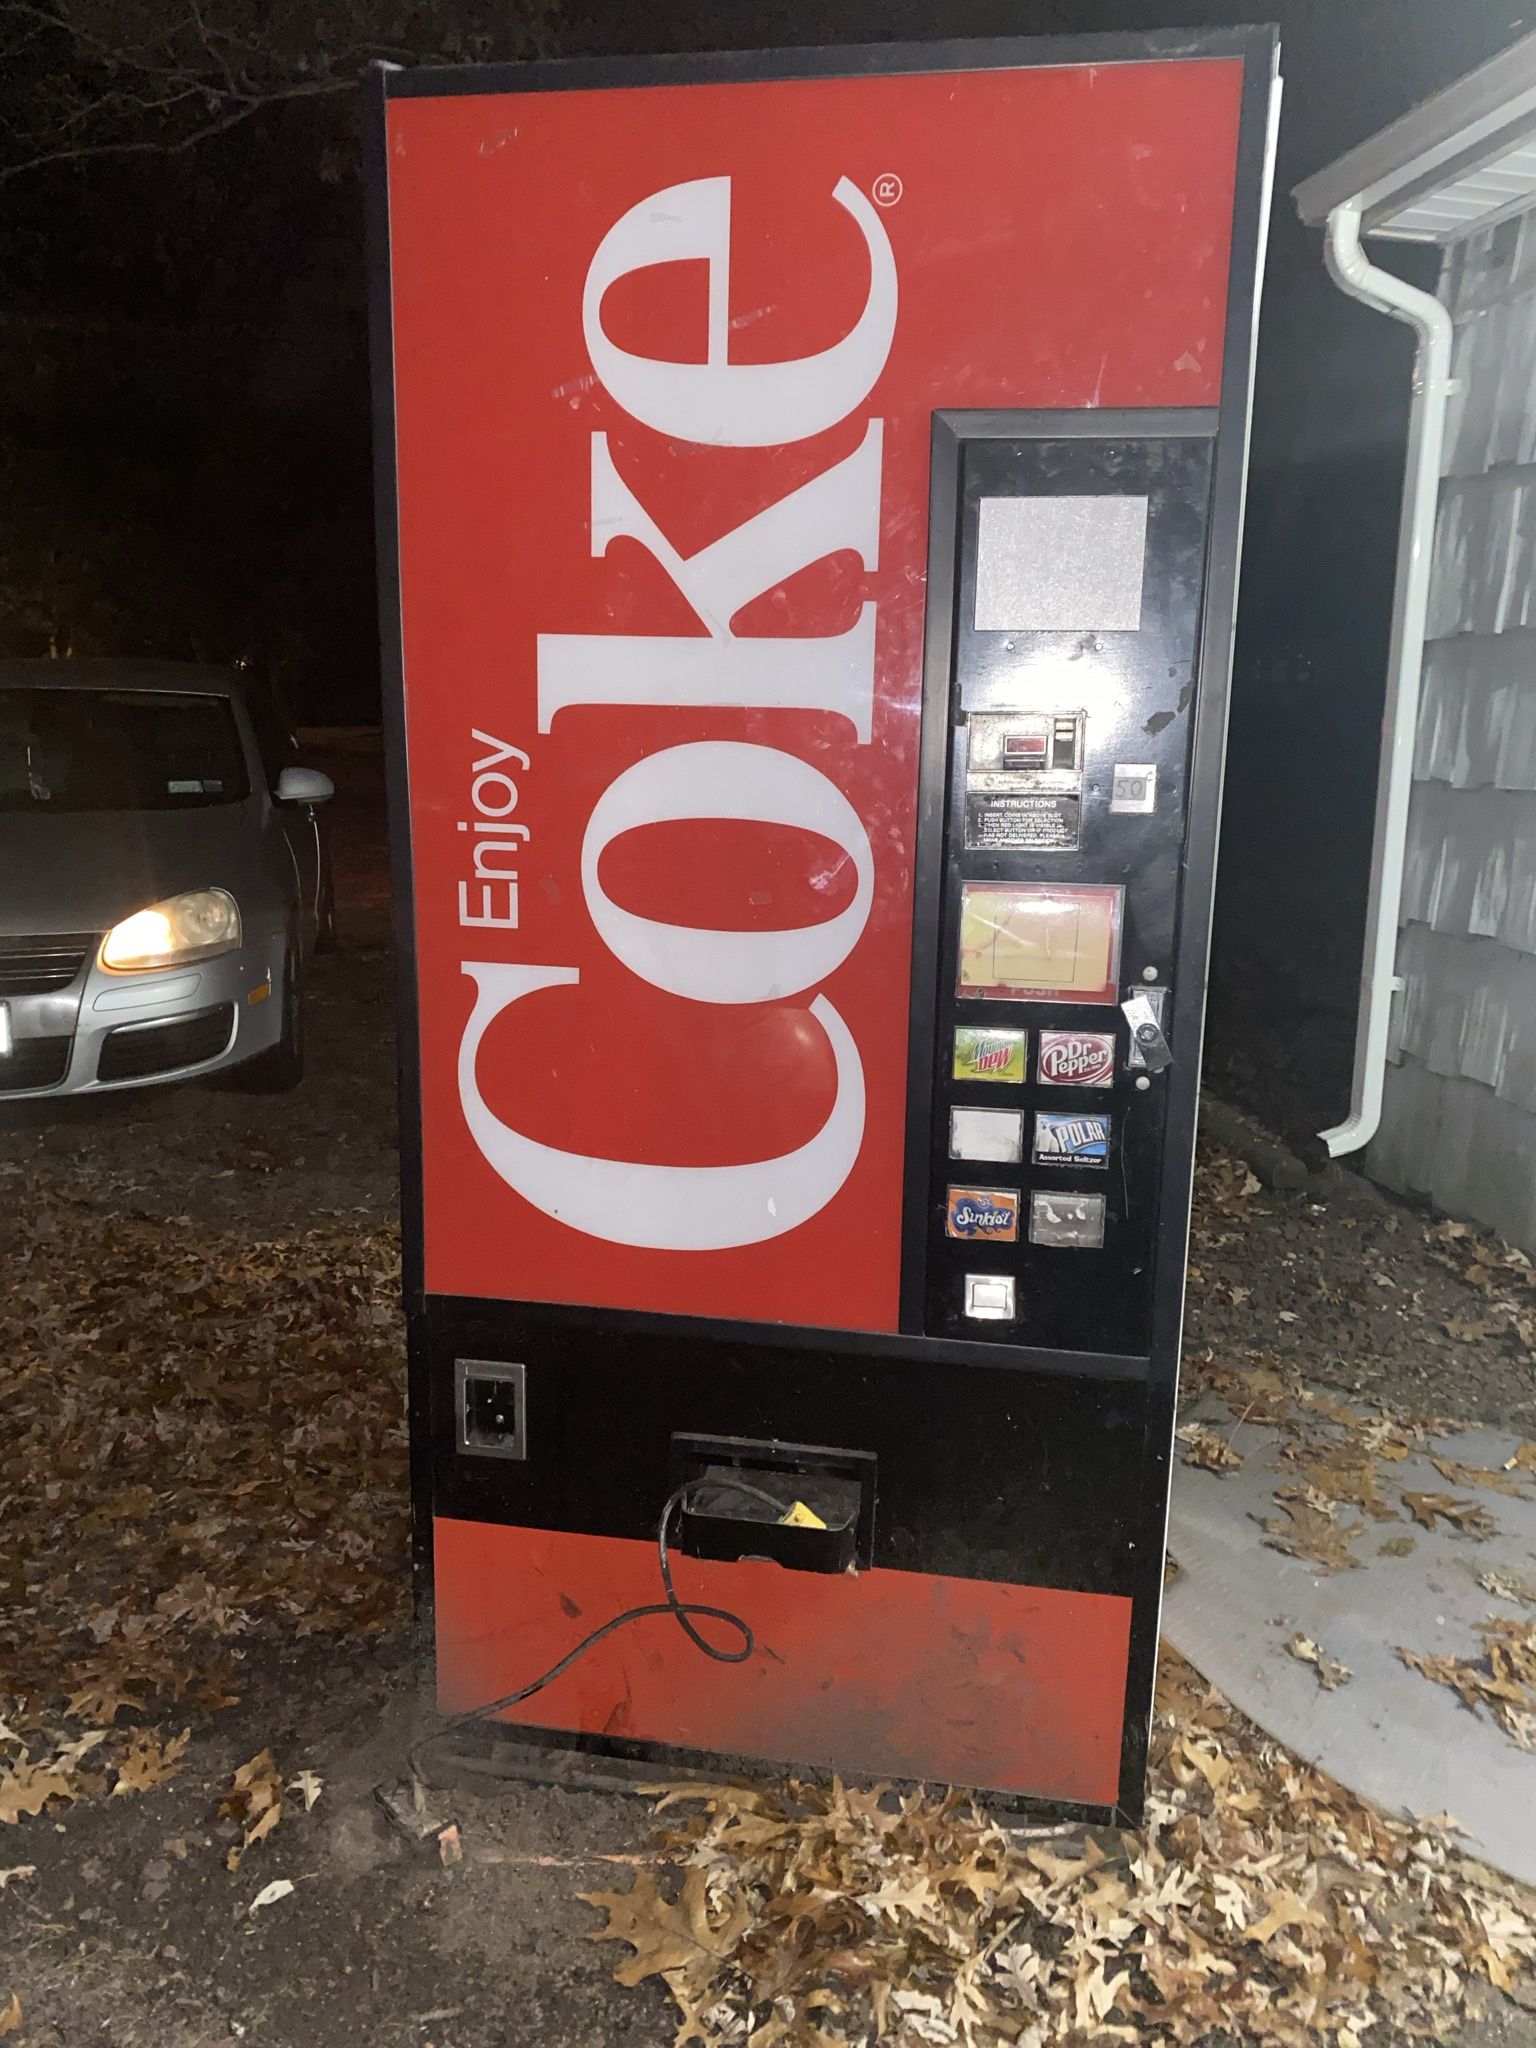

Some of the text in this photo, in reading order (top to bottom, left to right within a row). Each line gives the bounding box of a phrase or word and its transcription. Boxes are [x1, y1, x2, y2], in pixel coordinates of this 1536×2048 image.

[458, 175, 898, 1252] Coke
[990, 800, 1057, 808] INSTRUCTIONS
[457, 728, 531, 930] Enjoy
[1051, 1045, 1107, 1077] Pepper
[1067, 1040, 1092, 1060] Dr
[1055, 1121, 1106, 1153] POLAR
[1039, 1153, 1102, 1164] Assorted Seltzer
[956, 1206, 1011, 1226] Sunkist
